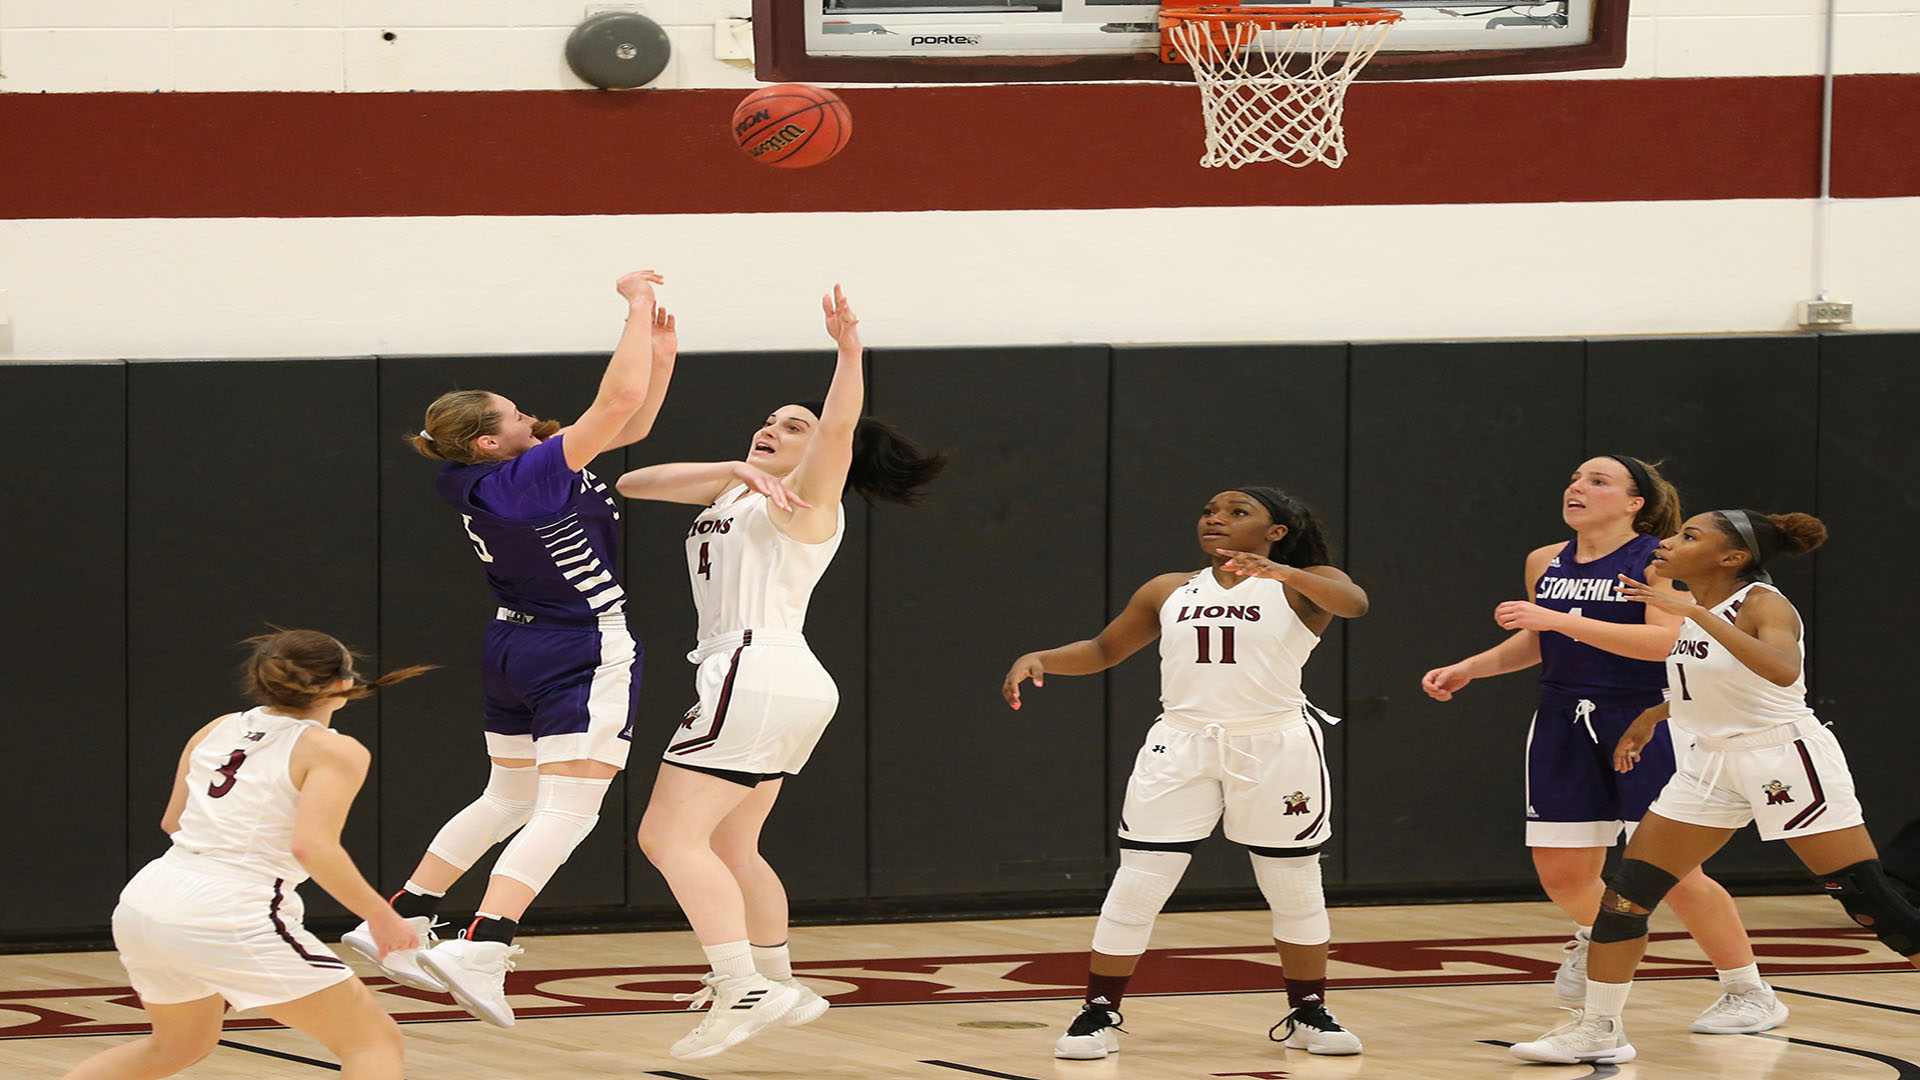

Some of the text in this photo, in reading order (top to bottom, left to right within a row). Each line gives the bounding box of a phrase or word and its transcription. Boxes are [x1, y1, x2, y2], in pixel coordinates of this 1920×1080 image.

[686, 517, 734, 538] IONS
[697, 541, 712, 581] 4
[1536, 576, 1628, 602] STONEHILL
[1176, 605, 1261, 623] LIONS
[1194, 625, 1237, 664] 11
[1668, 639, 1710, 660] IONS
[1675, 662, 1693, 701] 1
[207, 748, 247, 799] 3
